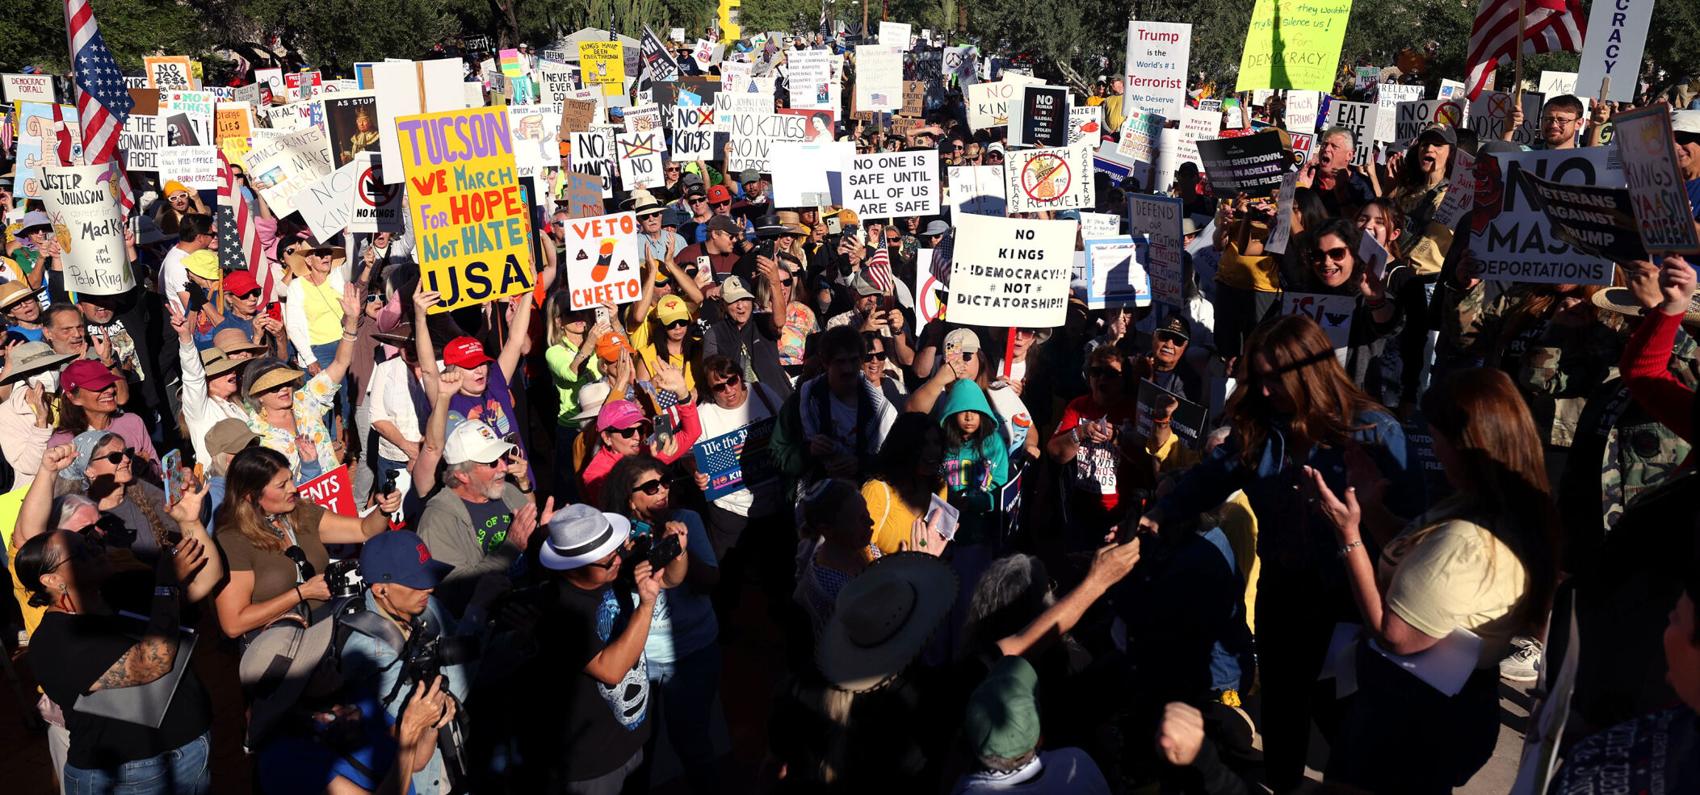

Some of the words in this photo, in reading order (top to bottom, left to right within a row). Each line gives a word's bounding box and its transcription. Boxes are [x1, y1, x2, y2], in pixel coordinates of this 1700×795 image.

[1138, 29, 1179, 44] Trump
[545, 51, 565, 60] DEFEND
[1247, 52, 1326, 69] DEMOCRACY
[157, 63, 178, 72] NO
[1136, 61, 1163, 69] World's
[11, 78, 47, 87] DEMOCRACY
[545, 72, 572, 82] NEVER
[1128, 75, 1182, 89] Terrorist
[18, 85, 30, 93] FOR
[30, 86, 44, 94] ALL
[550, 82, 572, 91] EVER
[986, 84, 1014, 99] NO
[1381, 84, 1421, 93] RELEASE
[182, 93, 203, 103] NO
[352, 97, 375, 106] STUP
[554, 93, 566, 101] GO
[639, 92, 648, 100] NO
[716, 94, 732, 111] NO
[1036, 94, 1054, 105] NO
[1132, 94, 1144, 102] We
[173, 102, 210, 114] KINGS
[569, 100, 591, 111] PROTECT
[979, 103, 1007, 115] KIN
[1401, 103, 1429, 121] NO
[678, 108, 698, 129] NO
[1288, 113, 1315, 125] TRUMP
[1337, 103, 1370, 124] EAT
[135, 117, 156, 133] THE
[731, 113, 754, 137] NO
[757, 115, 805, 139] KINGS
[1184, 124, 1212, 132] MATTERS
[1468, 115, 1488, 138] NO
[118, 135, 165, 150] RONMENT
[398, 111, 512, 166] TUCSON
[578, 133, 605, 159] NO
[674, 129, 711, 154] Kings
[246, 130, 320, 169] IMMIGRANTS
[731, 138, 752, 158] NO
[130, 153, 158, 168] AGAI
[291, 147, 331, 174] MAKE
[854, 159, 874, 171] NO
[878, 157, 907, 169] ONE
[913, 155, 926, 167] IS
[1023, 149, 1071, 163] IMPEACH
[1231, 152, 1284, 166] SHUTDOWN.
[516, 165, 534, 176] TION
[630, 157, 653, 176] NO
[730, 159, 743, 170] NO
[744, 159, 770, 173] FASC
[1234, 169, 1243, 177] IN
[1244, 164, 1282, 177] ADELITA.
[39, 168, 83, 191] JESTER
[411, 169, 448, 196] WE
[849, 173, 885, 186] SAFE
[893, 171, 931, 183] UNTIL
[1241, 178, 1259, 187] THE
[1259, 175, 1284, 185] FILES
[1503, 157, 1596, 212] NO
[310, 171, 354, 206] NO
[853, 189, 880, 200] ALL
[886, 187, 905, 199] OF
[911, 186, 929, 197] US
[57, 189, 104, 206] JOHNSON
[356, 208, 369, 218] NO
[369, 209, 395, 218] KINGS
[449, 186, 522, 225] HOPE
[858, 203, 888, 215] ARE
[895, 200, 930, 213] SAFE
[1135, 199, 1175, 220] DEFEND
[315, 199, 351, 236] KIN
[1549, 206, 1618, 226] AGAINST
[81, 220, 110, 241] Mad
[573, 215, 634, 240] VETO
[1015, 229, 1035, 240] NO
[423, 235, 459, 263] NOT
[461, 217, 524, 256] HATE
[1487, 222, 1585, 256] MAS
[998, 248, 1044, 260] KINGS
[1478, 260, 1604, 280] DEPORTATIONS
[95, 268, 123, 291] Ring
[428, 254, 535, 308] U.S.A.
[572, 278, 640, 308] CHEETO
[1003, 282, 1032, 294] NOT
[957, 293, 1064, 309] DICTATORSHIP!!
[701, 440, 721, 456] We
[722, 435, 739, 451] the
[728, 470, 743, 481] KIN
[485, 516, 498, 528] OF
